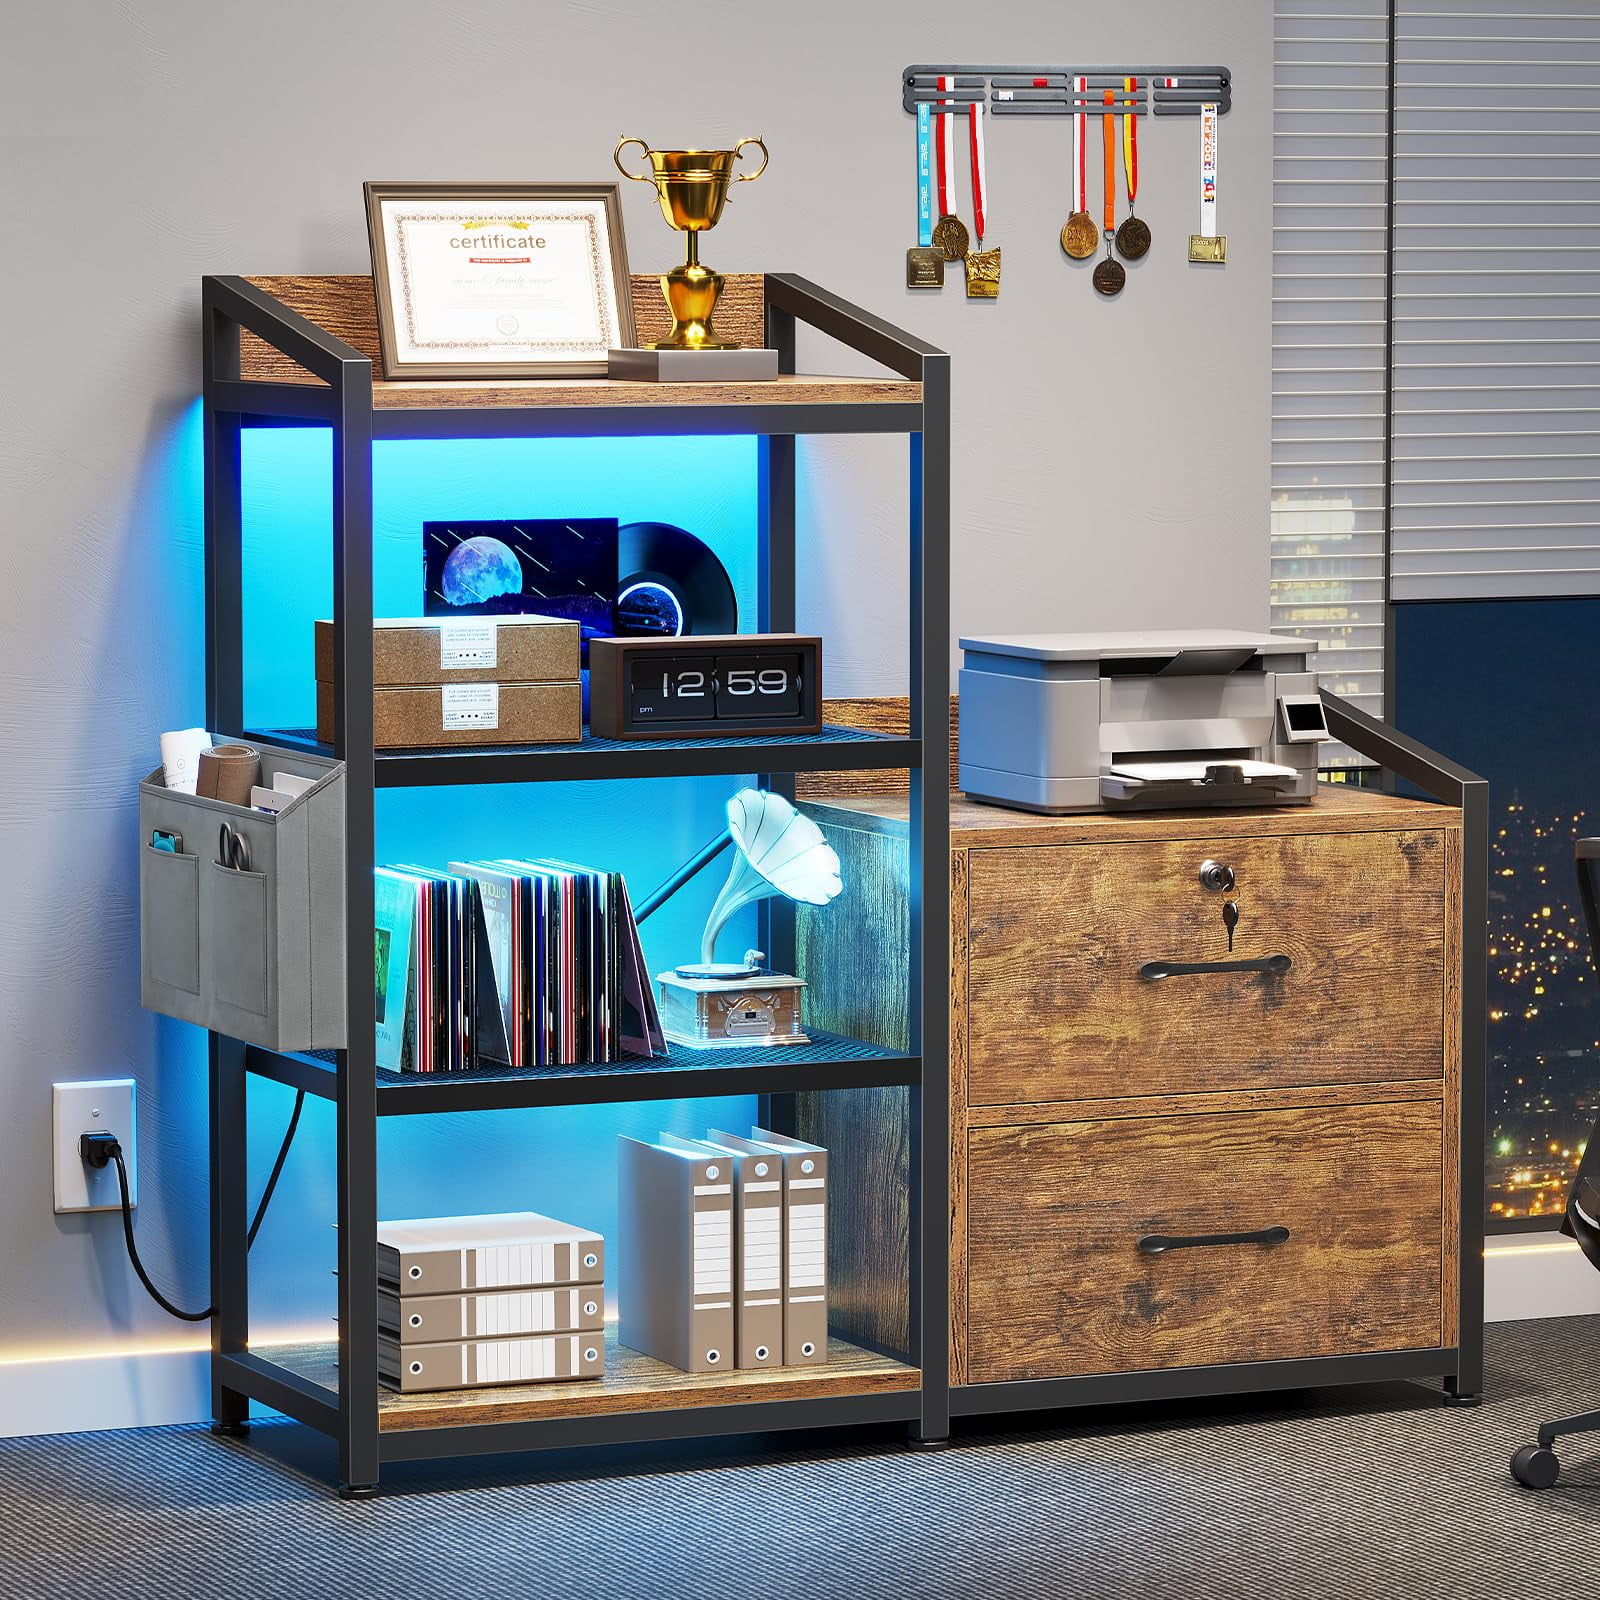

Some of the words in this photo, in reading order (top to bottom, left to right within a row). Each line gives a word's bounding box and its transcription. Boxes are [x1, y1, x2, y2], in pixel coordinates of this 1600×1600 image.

[449, 234, 546, 249] certificate
[662, 671, 705, 698] 12
[727, 669, 788, 696] 59
